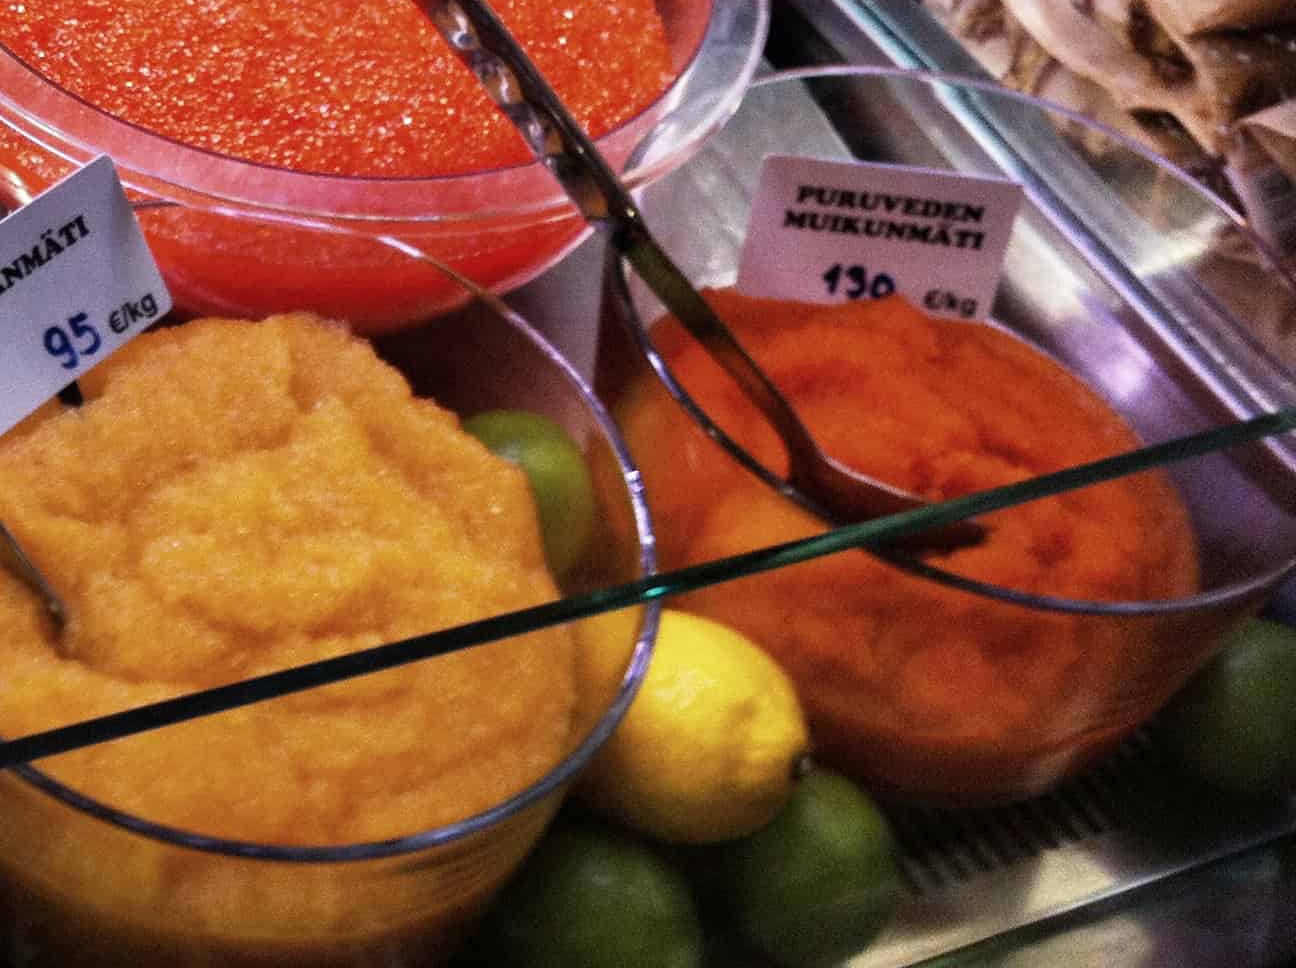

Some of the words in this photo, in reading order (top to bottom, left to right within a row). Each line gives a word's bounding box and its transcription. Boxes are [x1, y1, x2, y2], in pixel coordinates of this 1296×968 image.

[796, 186, 986, 222] PURUVEDEN
[783, 210, 986, 251] MUIKUNMÄTI
[923, 290, 978, 318] €/kg
[43, 312, 102, 369] 95
[107, 292, 159, 334] €/kg
